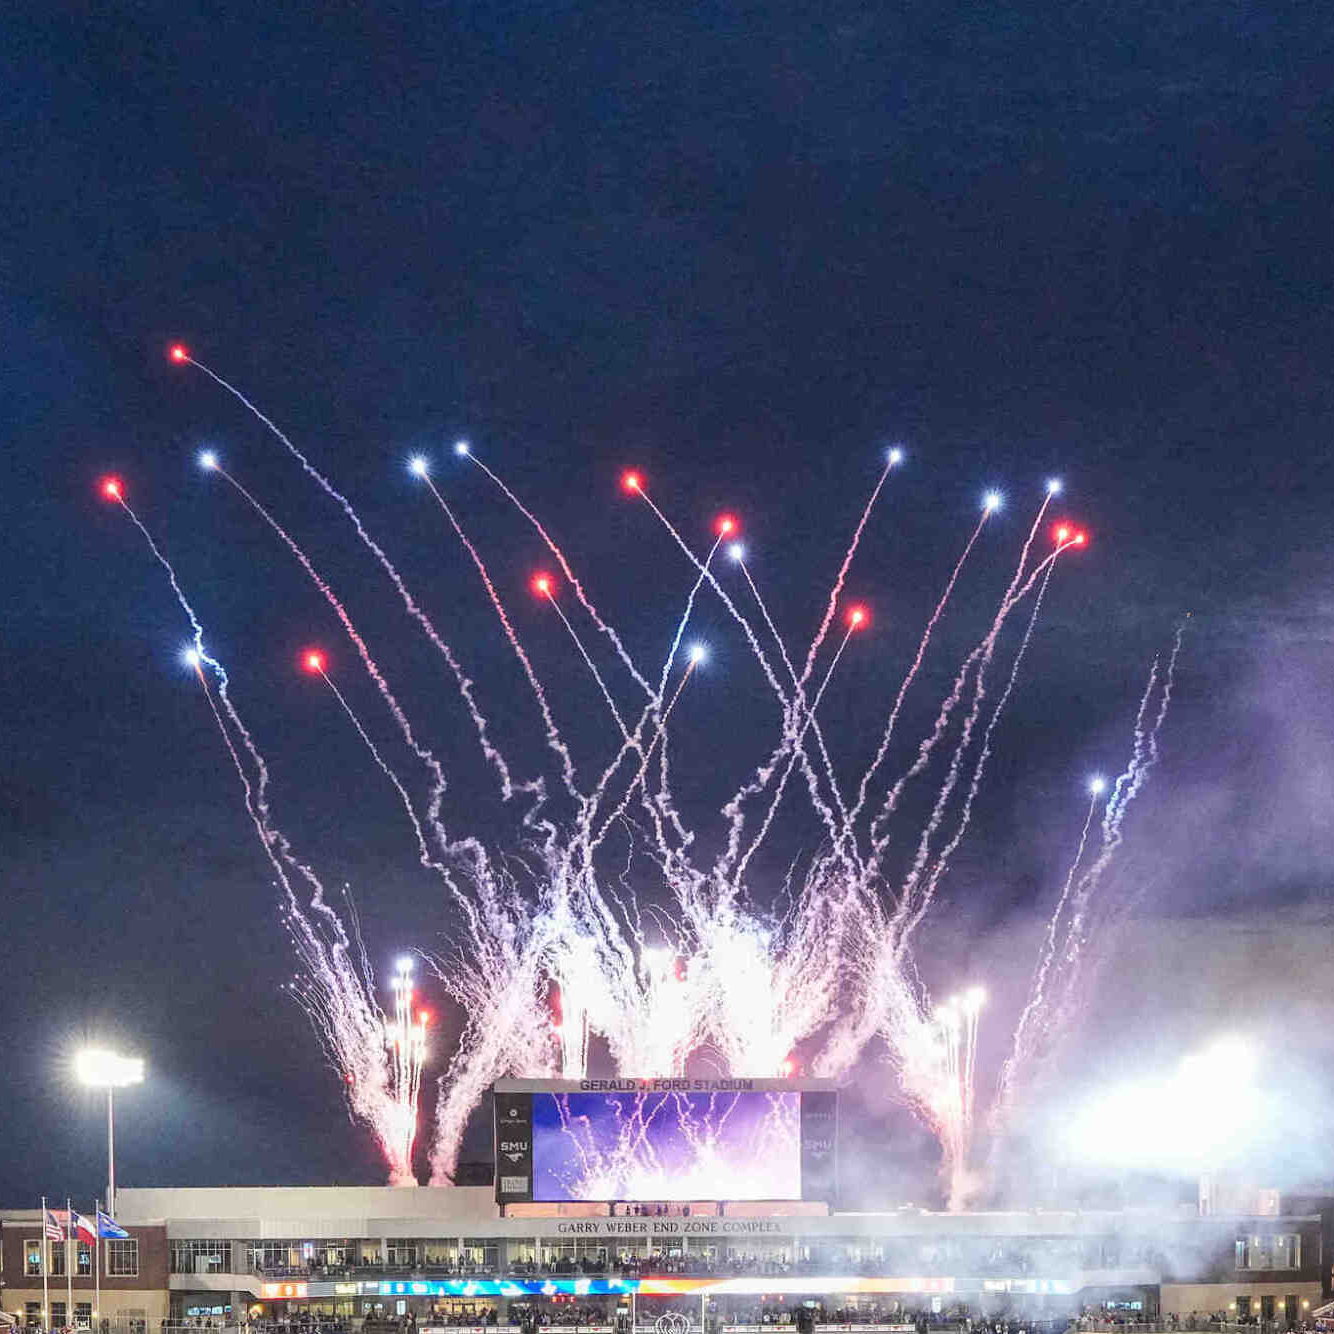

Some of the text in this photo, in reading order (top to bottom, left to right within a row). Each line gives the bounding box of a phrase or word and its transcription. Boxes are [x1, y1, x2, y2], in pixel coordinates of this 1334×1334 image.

[579, 1079, 636, 1091] GERALD
[652, 1079, 692, 1091] FORD
[694, 1079, 753, 1091] STADIUM
[500, 1142, 528, 1152] SMU
[557, 1222, 781, 1234] GARRY WEBER END ZONE COMPLEX
